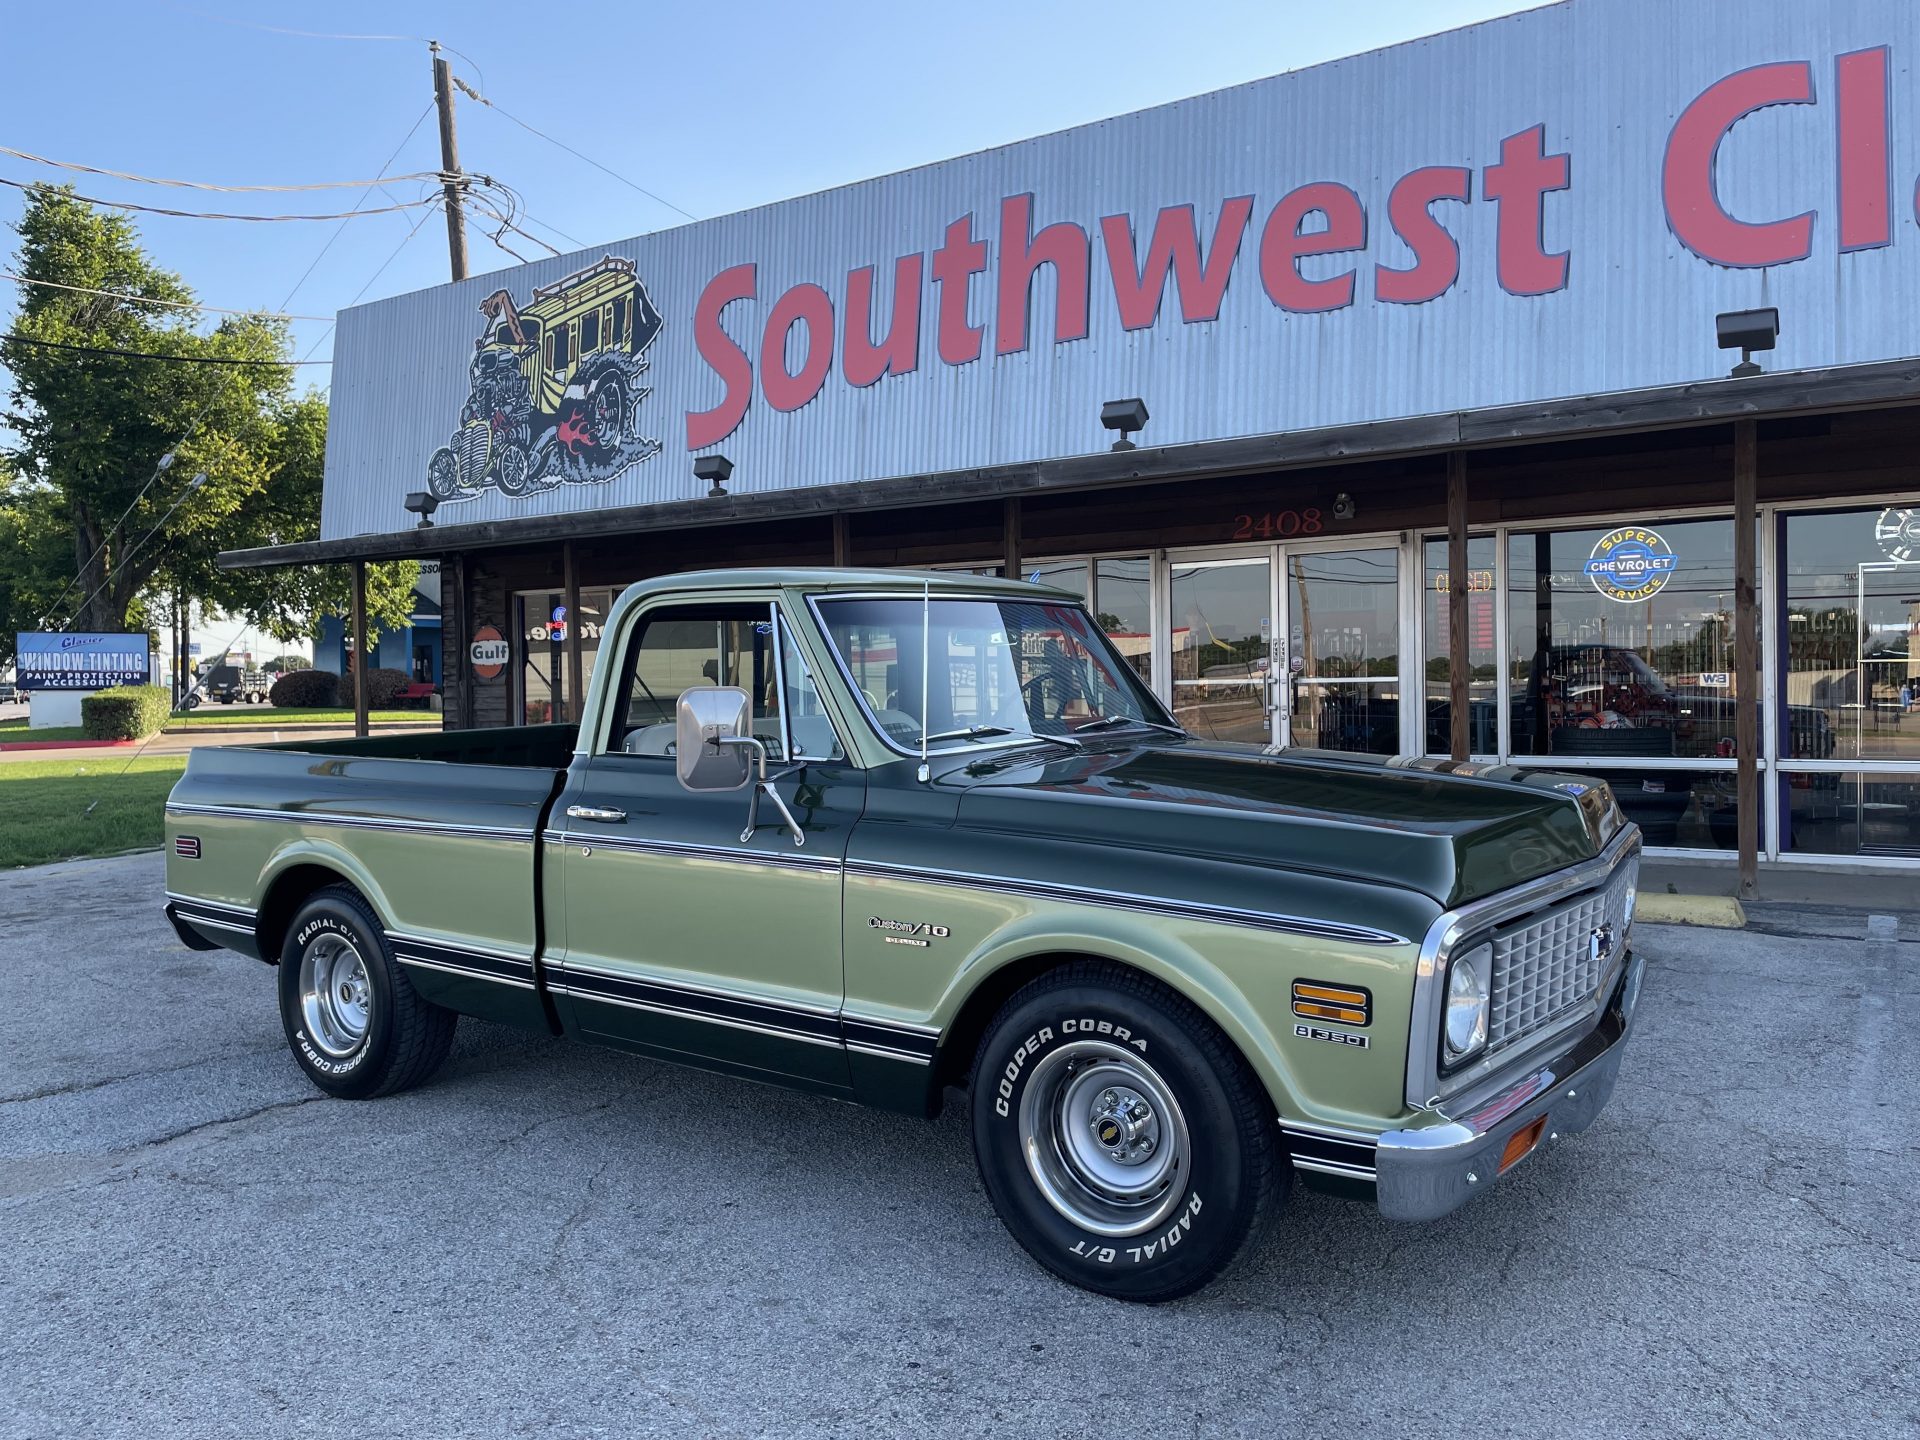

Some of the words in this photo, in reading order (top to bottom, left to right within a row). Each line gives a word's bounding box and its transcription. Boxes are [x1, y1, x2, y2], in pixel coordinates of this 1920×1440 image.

[685, 122, 1571, 452] Southwest
[1661, 44, 1920, 270] Cl
[1232, 507, 1322, 539] 2408
[1601, 530, 1658, 551] SUPER
[1590, 558, 1671, 572] CHEVROLET
[1599, 578, 1662, 600] SERVICE
[61, 636, 104, 649] Glacier
[472, 644, 508, 660] Gulf
[23, 652, 84, 671] WINDOW
[88, 652, 143, 672] TINTING
[26, 672, 62, 680] PAINT
[67, 672, 141, 680] PROTECTION
[43, 679, 124, 687] ACCESSORIES
[297, 918, 337, 946] RADIAL
[295, 1029, 332, 1072] COBRA
[332, 1033, 372, 1074] COOPER
[995, 1026, 1054, 1118] COOPER
[1062, 1018, 1148, 1053] COBRA
[1126, 1191, 1203, 1263] RADIAL
[1068, 1240, 1116, 1264] G/T
